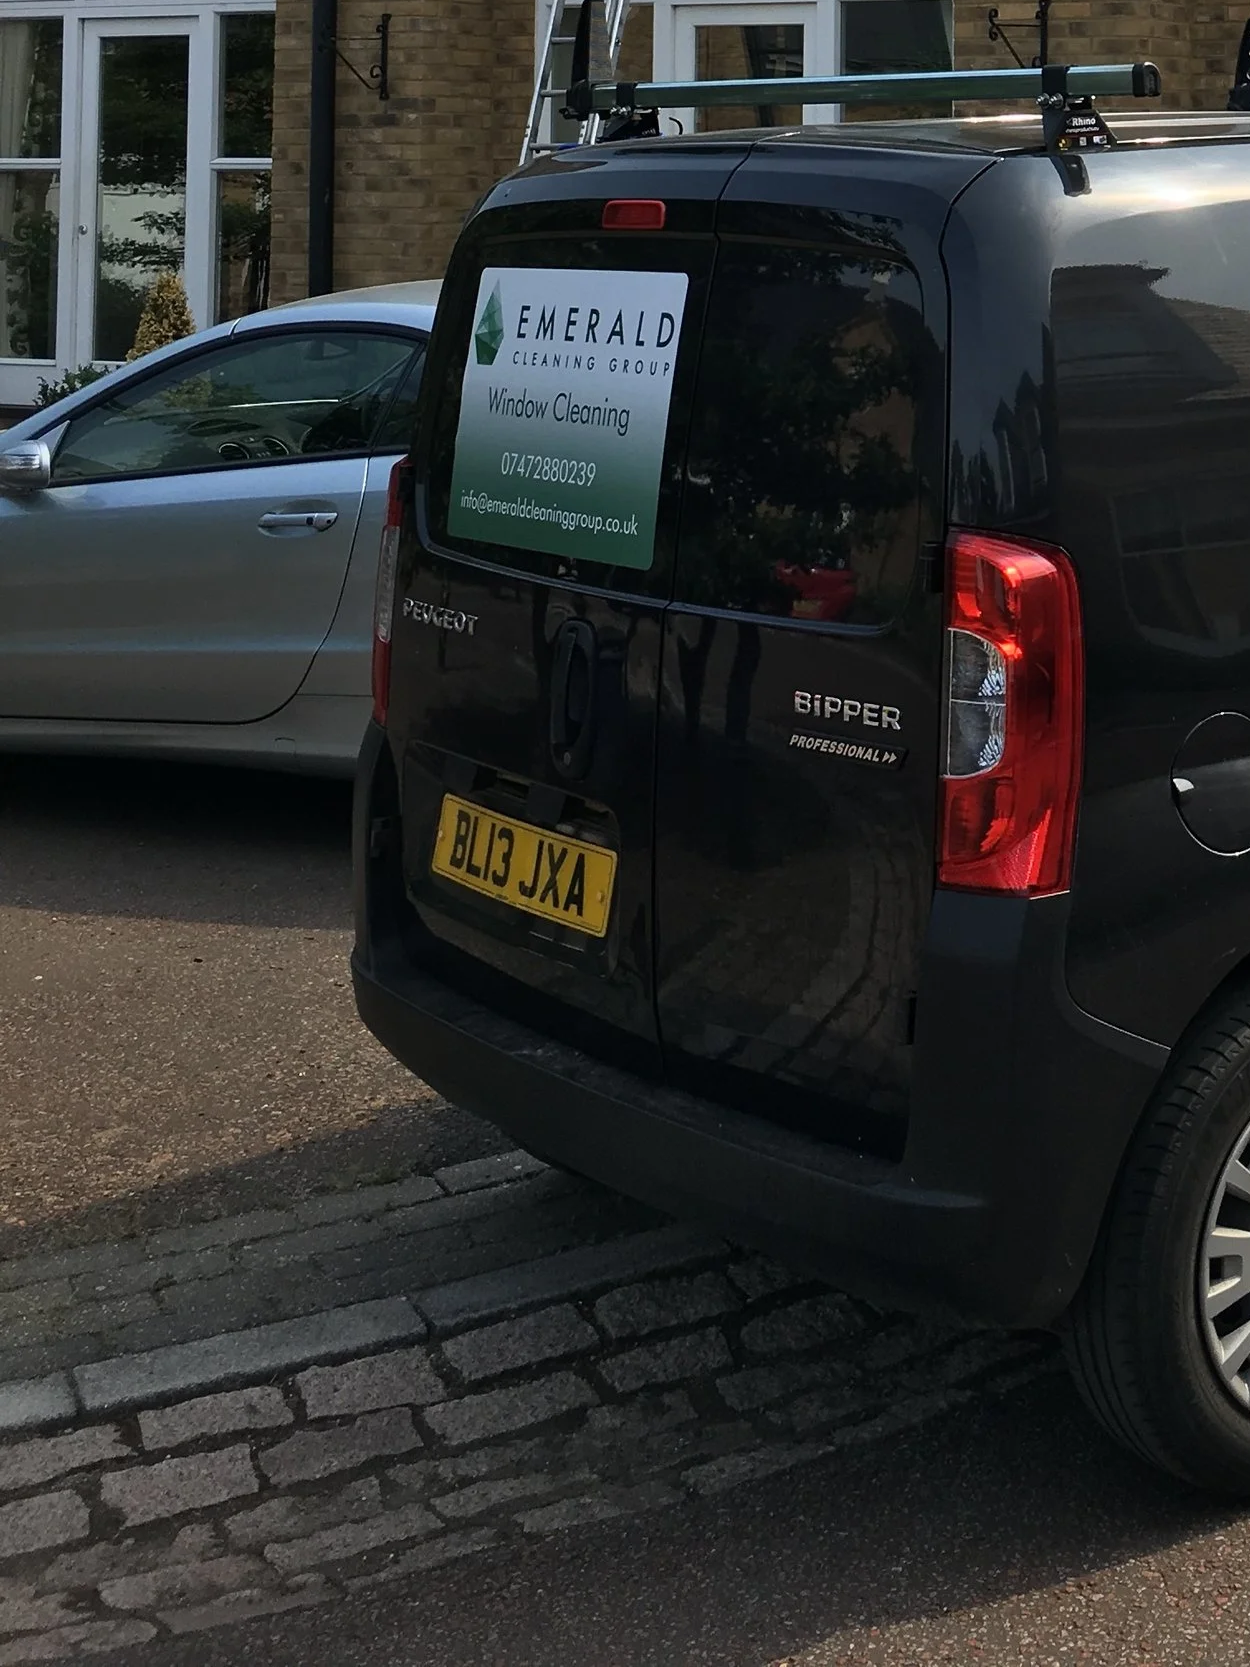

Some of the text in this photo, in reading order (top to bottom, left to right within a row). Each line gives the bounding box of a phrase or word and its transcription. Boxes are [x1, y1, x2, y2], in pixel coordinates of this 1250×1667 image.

[516, 305, 676, 348] EMERALD
[512, 351, 671, 376] CLEANING GROUP
[488, 386, 631, 436] Window Cleaning
[501, 452, 597, 487] 07472880239
[460, 489, 638, 536] info@emeraldcleaninggroup.co.uk
[403, 597, 479, 636] PEUGEOT
[788, 734, 881, 763] PROFESSIONAL
[449, 809, 586, 917] BL13 JXA
